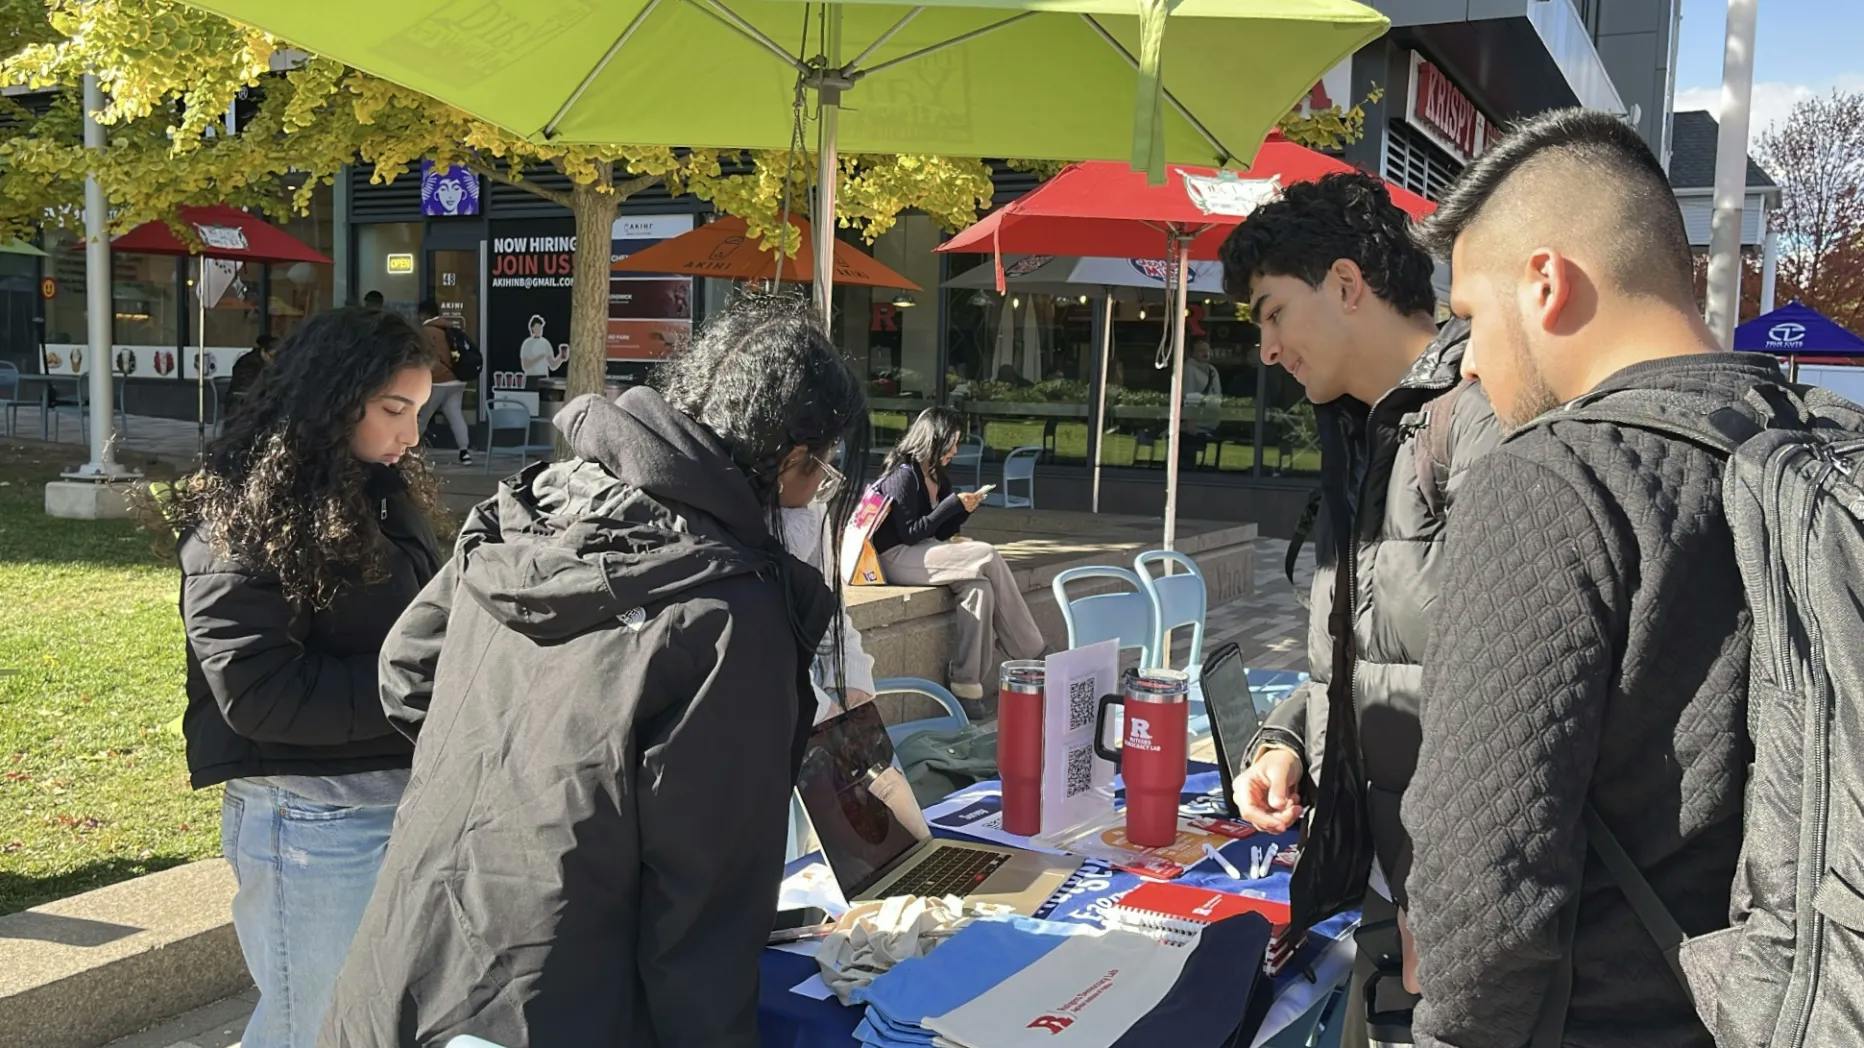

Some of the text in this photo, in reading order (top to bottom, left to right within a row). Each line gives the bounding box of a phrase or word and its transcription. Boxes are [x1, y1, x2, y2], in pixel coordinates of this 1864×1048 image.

[1424, 62, 1475, 152] KRISPY
[494, 238, 527, 253] NOW
[492, 254, 539, 275] JOIN
[1131, 717, 1152, 738] R
[1027, 1015, 1074, 1035] R
